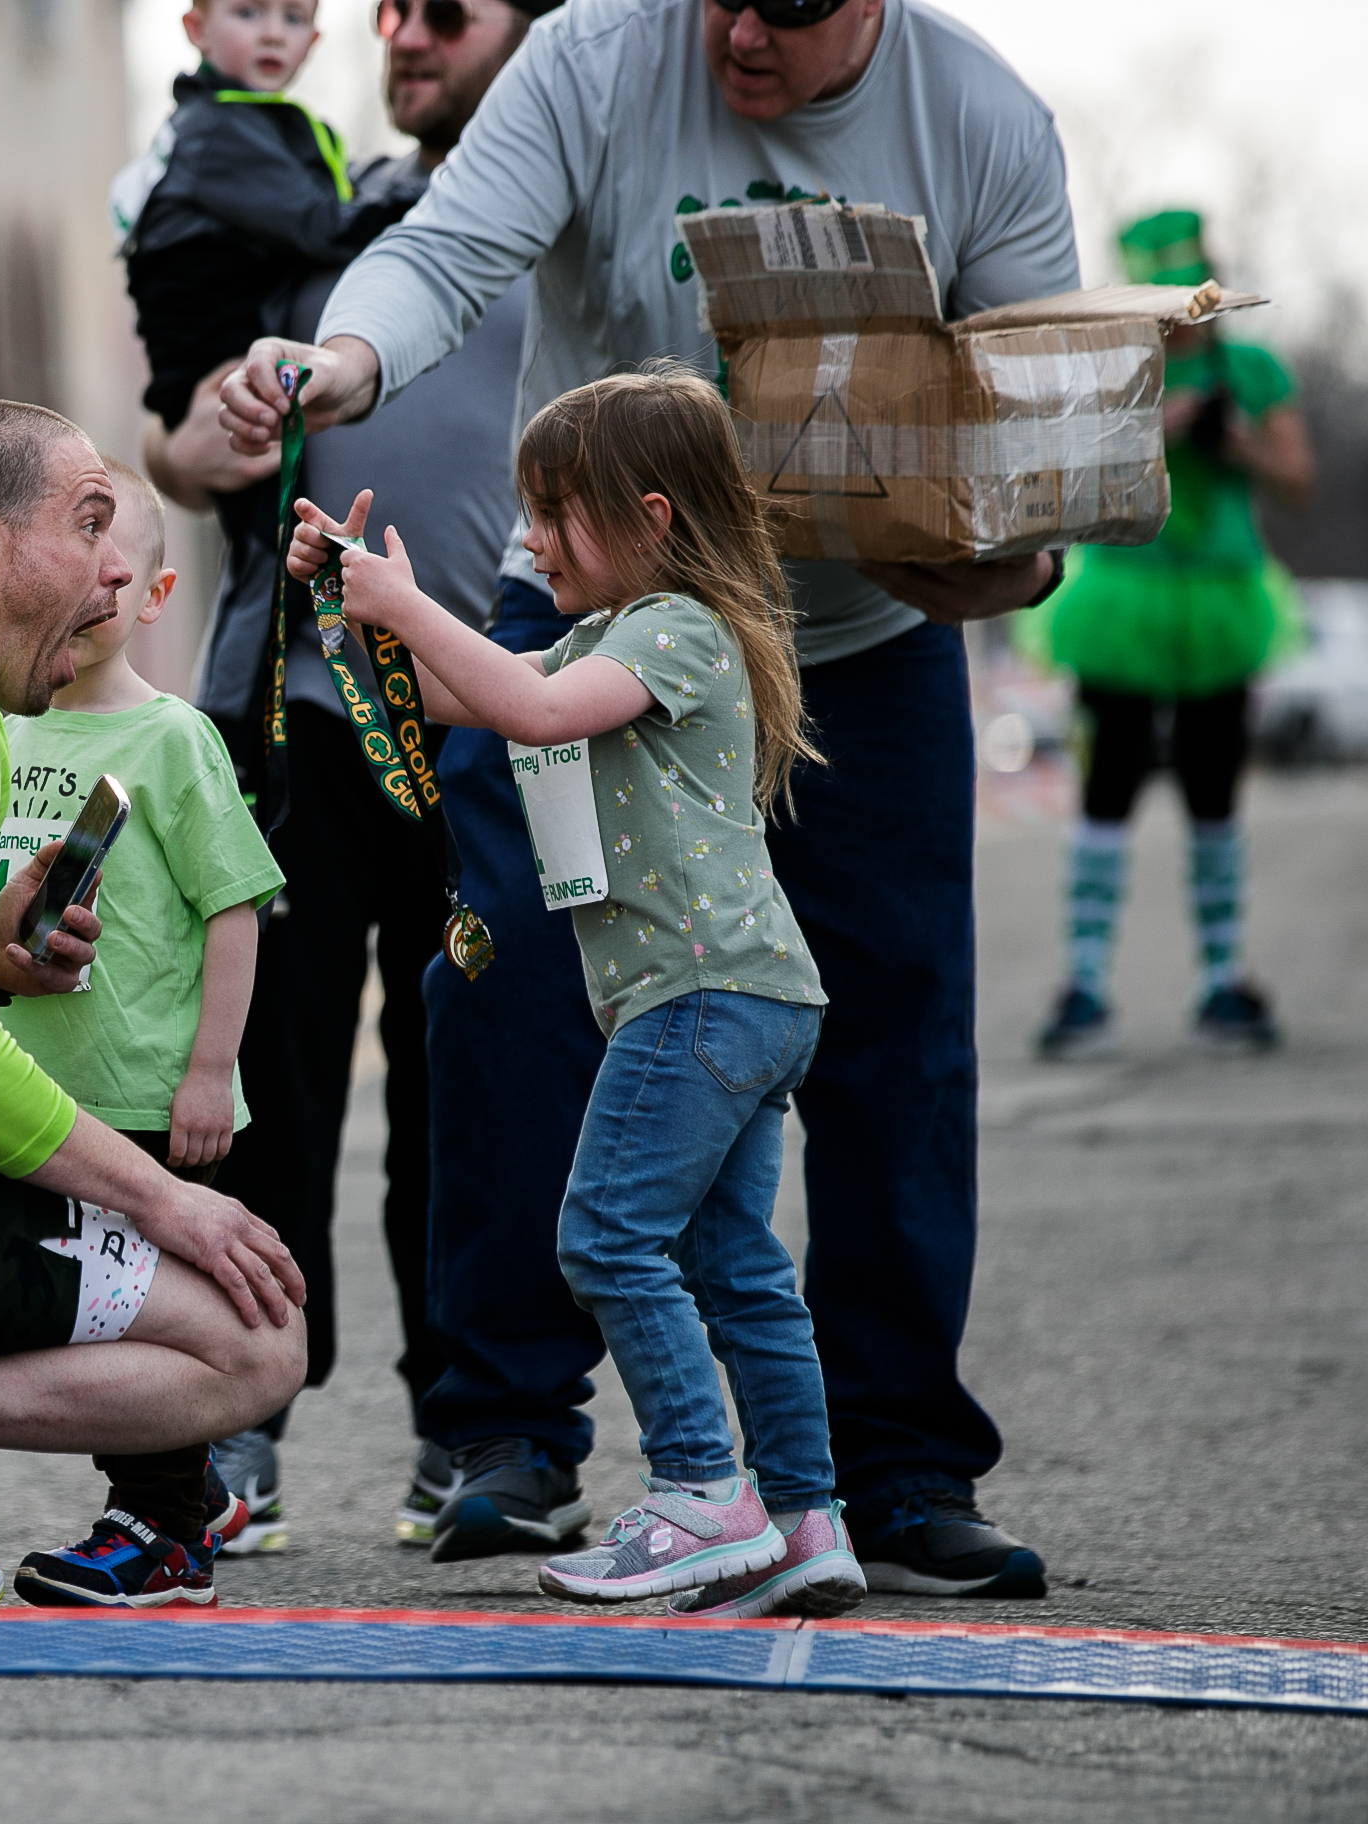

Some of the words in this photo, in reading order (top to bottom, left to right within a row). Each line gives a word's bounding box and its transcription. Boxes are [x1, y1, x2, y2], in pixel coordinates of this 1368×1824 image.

[332, 662, 373, 725] Pot
[373, 626, 402, 666] ot
[399, 718, 441, 806] Gold
[540, 743, 581, 767] Trot
[548, 876, 595, 900] RUNNER
